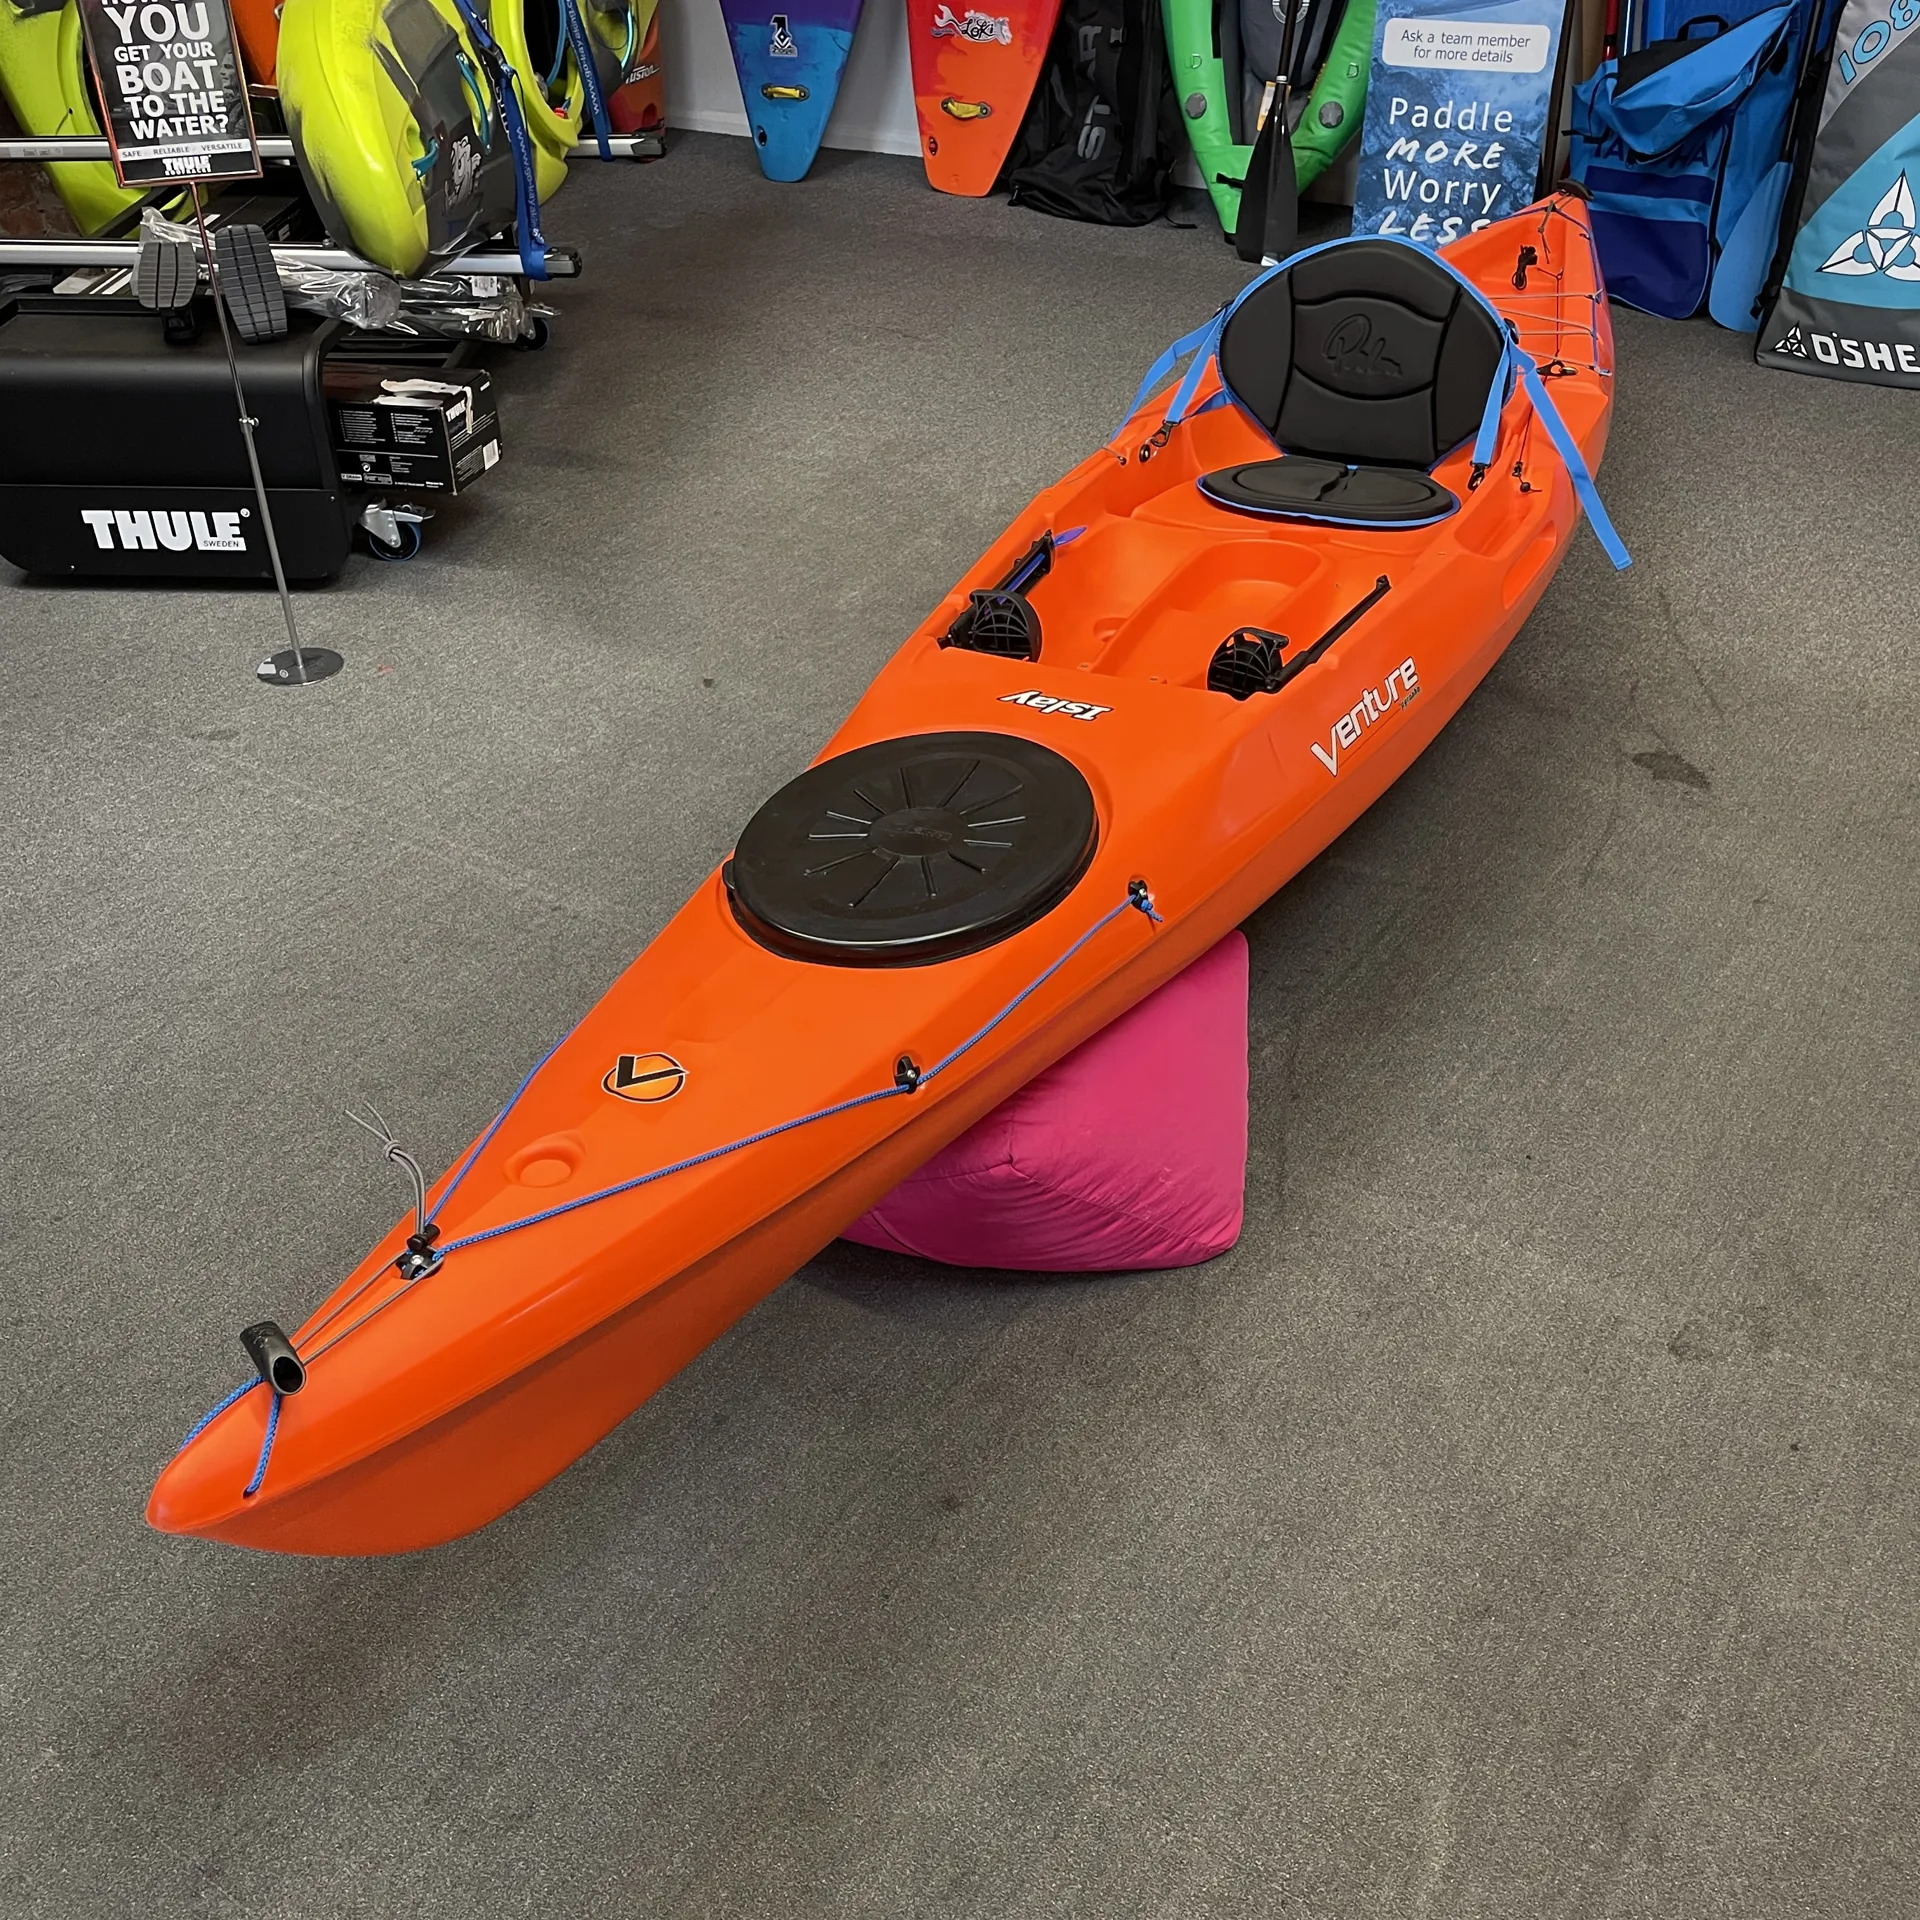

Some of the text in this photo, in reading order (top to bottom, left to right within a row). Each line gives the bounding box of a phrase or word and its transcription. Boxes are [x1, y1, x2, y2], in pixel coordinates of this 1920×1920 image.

[103, 3, 210, 44] YOU
[114, 42, 216, 62] GET YOUR
[1401, 29, 1531, 48] Ask a team member
[1414, 45, 1513, 63] for more details
[116, 59, 218, 95] BOAT
[123, 90, 227, 118] TO THE
[1389, 97, 1513, 133] Paddle
[130, 114, 229, 140] WATER?
[122, 143, 243, 158] SAFE RELIABLE VERSATILE
[162, 156, 210, 171] THULE
[1385, 136, 1506, 170] MORE
[1383, 168, 1502, 214] Worry
[80, 509, 247, 552] THULE
[203, 540, 239, 548] SWEDEN
[997, 690, 1113, 721] Islay
[1310, 656, 1419, 777] Venture
